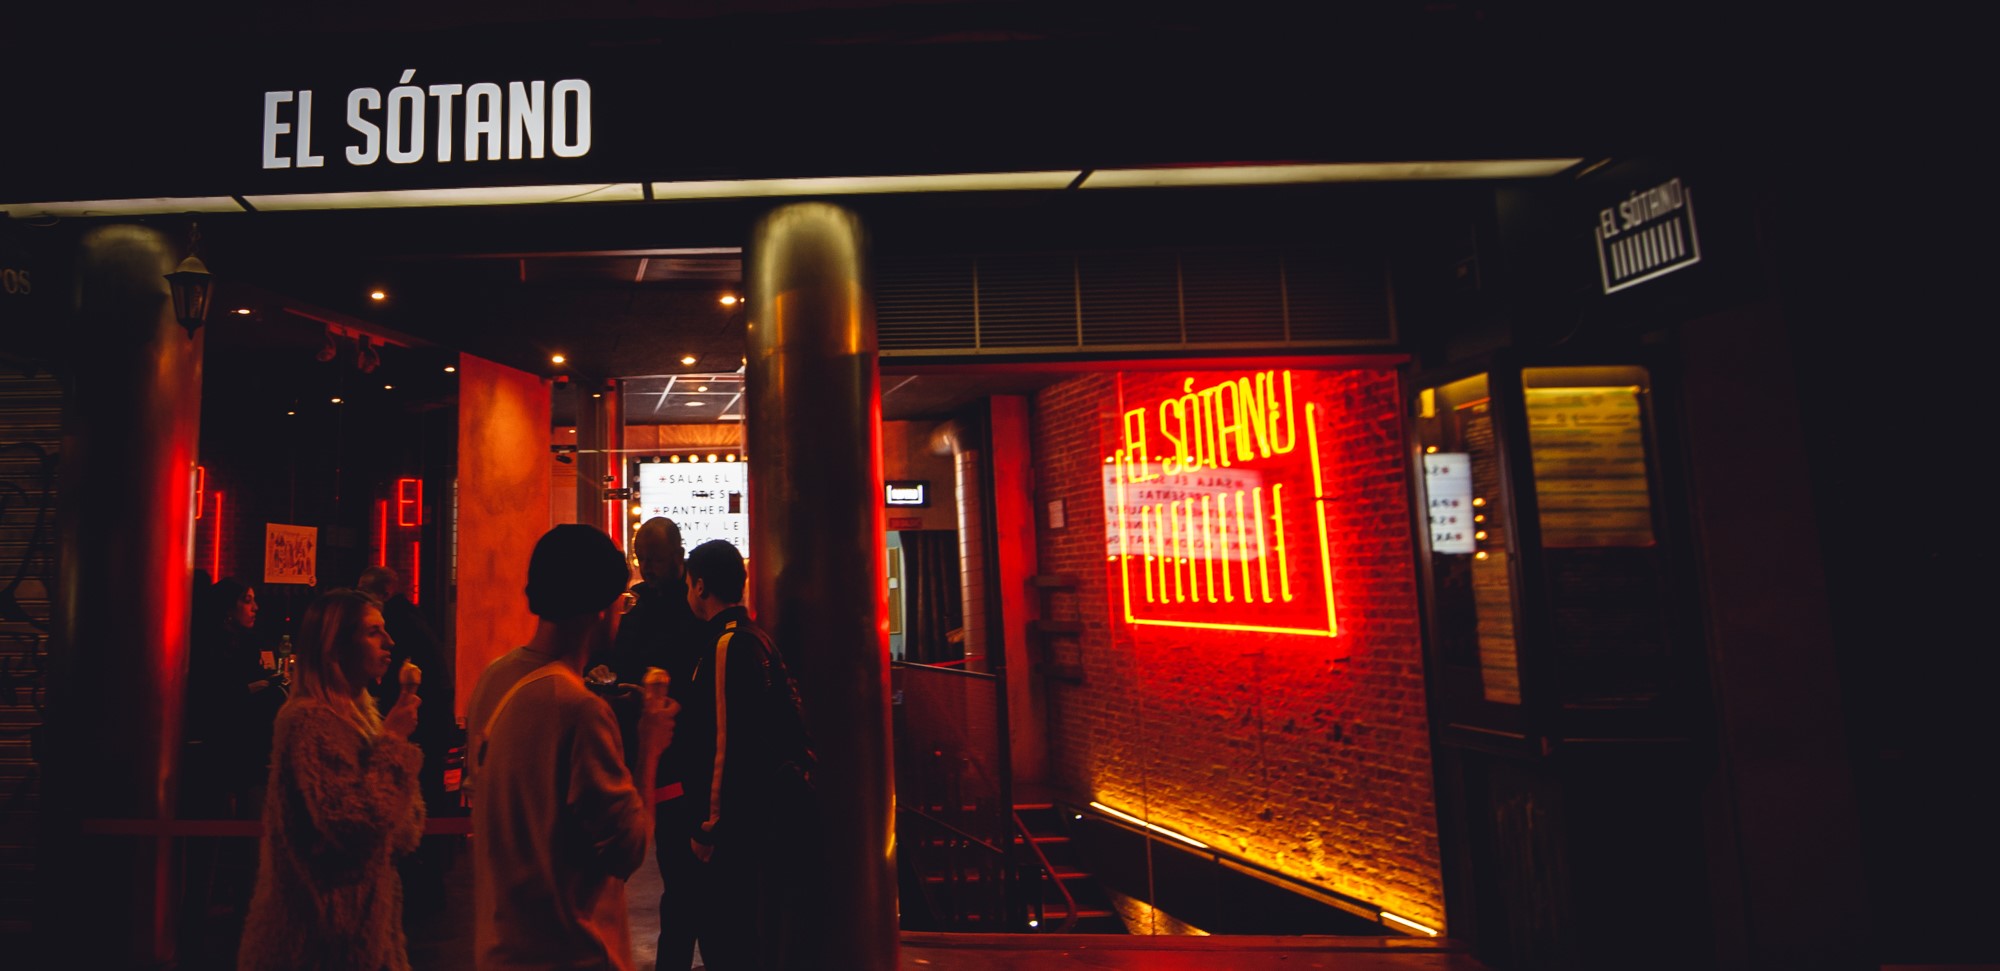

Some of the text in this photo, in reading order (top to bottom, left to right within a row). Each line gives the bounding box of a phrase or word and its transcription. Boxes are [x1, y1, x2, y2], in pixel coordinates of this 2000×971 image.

[263, 69, 591, 169] EL SÓTANO
[1600, 207, 1620, 239] EL
[0, 267, 31, 295] OS
[1124, 408, 1159, 484] EL
[669, 475, 730, 483] SALA EL
[724, 521, 739, 531] LE
